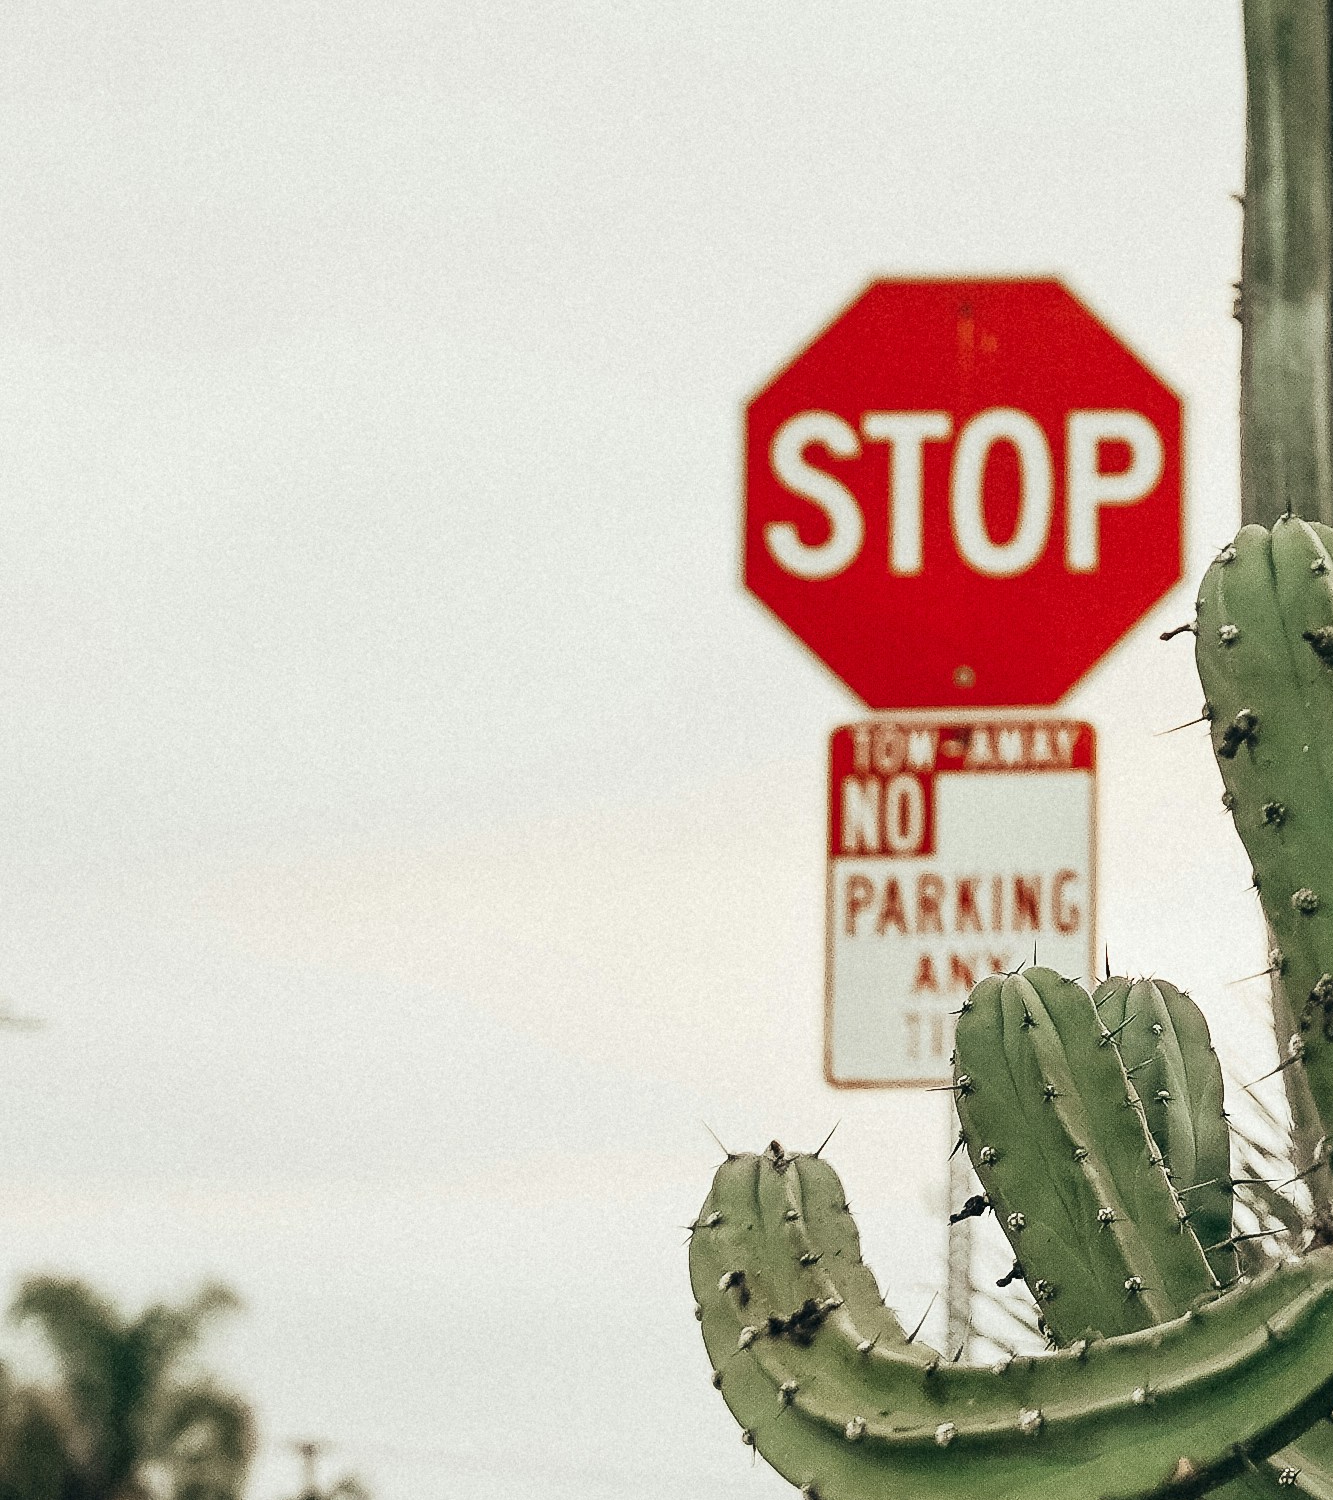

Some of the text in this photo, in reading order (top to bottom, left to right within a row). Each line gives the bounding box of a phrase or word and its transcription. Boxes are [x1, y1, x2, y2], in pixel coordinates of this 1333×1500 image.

[764, 408, 1164, 579] STOP
[843, 774, 925, 851] NO
[844, 869, 1080, 937] PARKING
